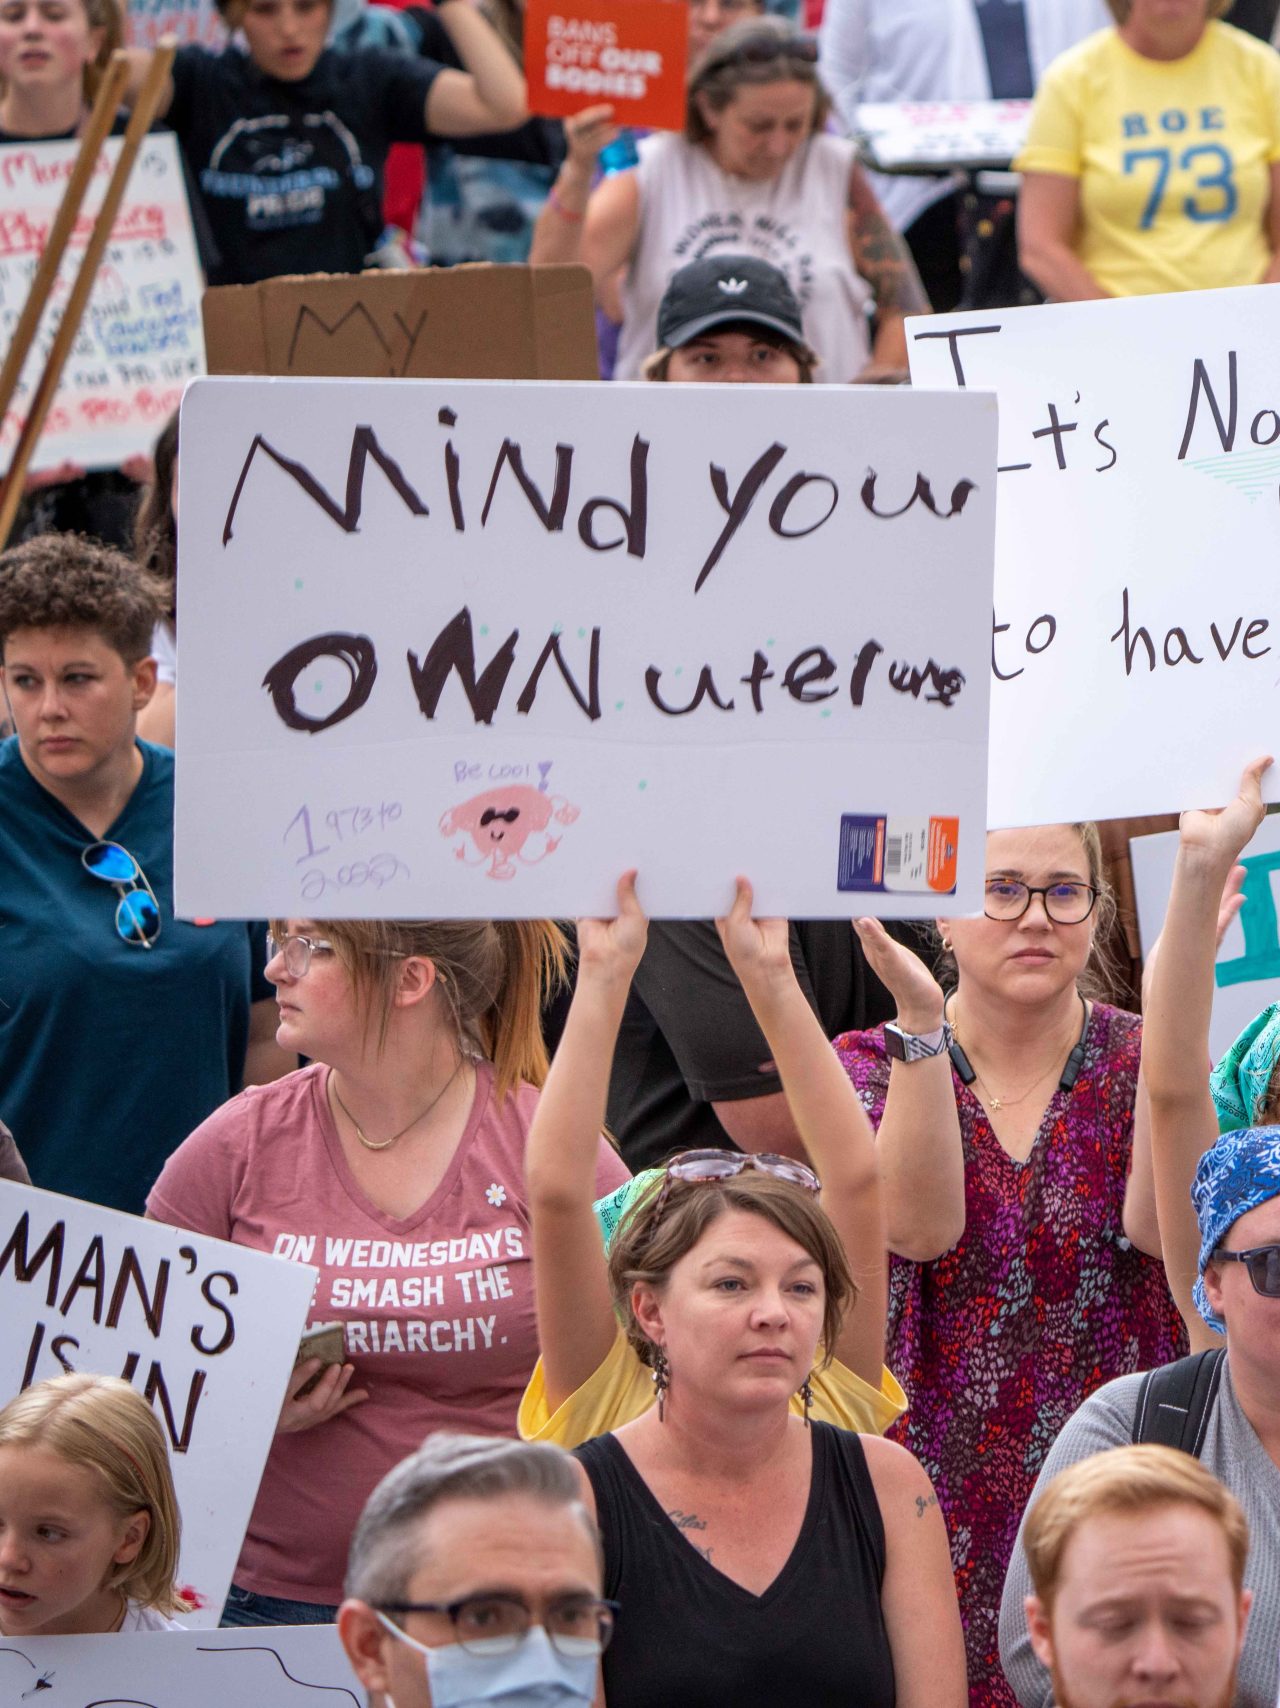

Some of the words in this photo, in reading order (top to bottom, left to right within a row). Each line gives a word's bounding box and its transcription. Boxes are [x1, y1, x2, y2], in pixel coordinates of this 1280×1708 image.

[547, 15, 618, 46] BANS
[545, 62, 646, 99] BODIES
[599, 47, 661, 77] OUR
[1122, 106, 1226, 138] ROE
[1122, 143, 1238, 231] 73
[288, 300, 429, 377] MY
[991, 605, 1057, 681] to
[1110, 586, 1272, 676] have
[272, 1232, 317, 1264] ON
[325, 1226, 524, 1268] WEDNESDAYS
[0, 1210, 239, 1356] MAN'S
[330, 1275, 445, 1308] SMASH
[455, 1265, 514, 1304] THE
